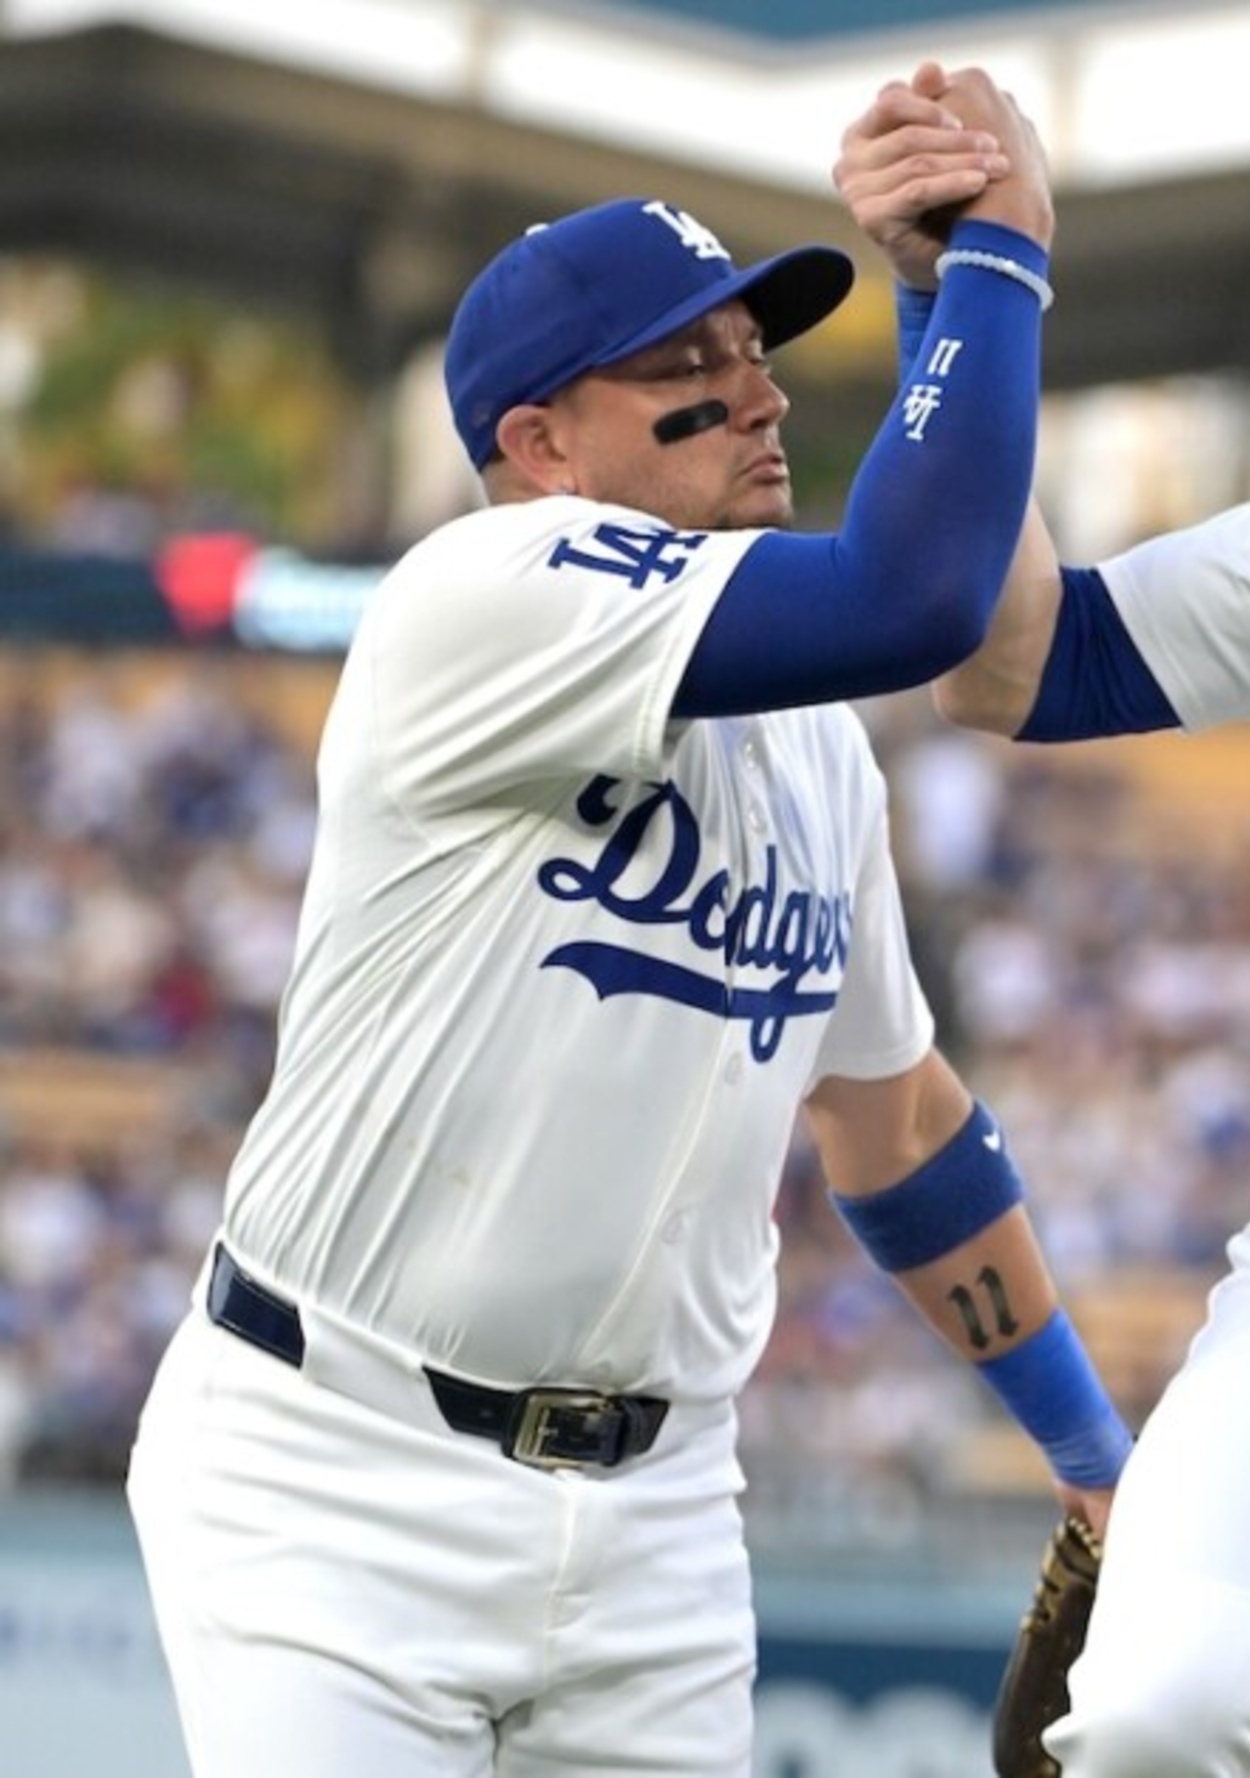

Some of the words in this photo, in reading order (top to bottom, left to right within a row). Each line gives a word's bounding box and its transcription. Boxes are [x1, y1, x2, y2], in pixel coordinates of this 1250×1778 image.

[641, 200, 731, 261] LA
[547, 523, 709, 590] LA
[537, 774, 853, 1063] Dodger
[948, 1264, 1019, 1349] 11
